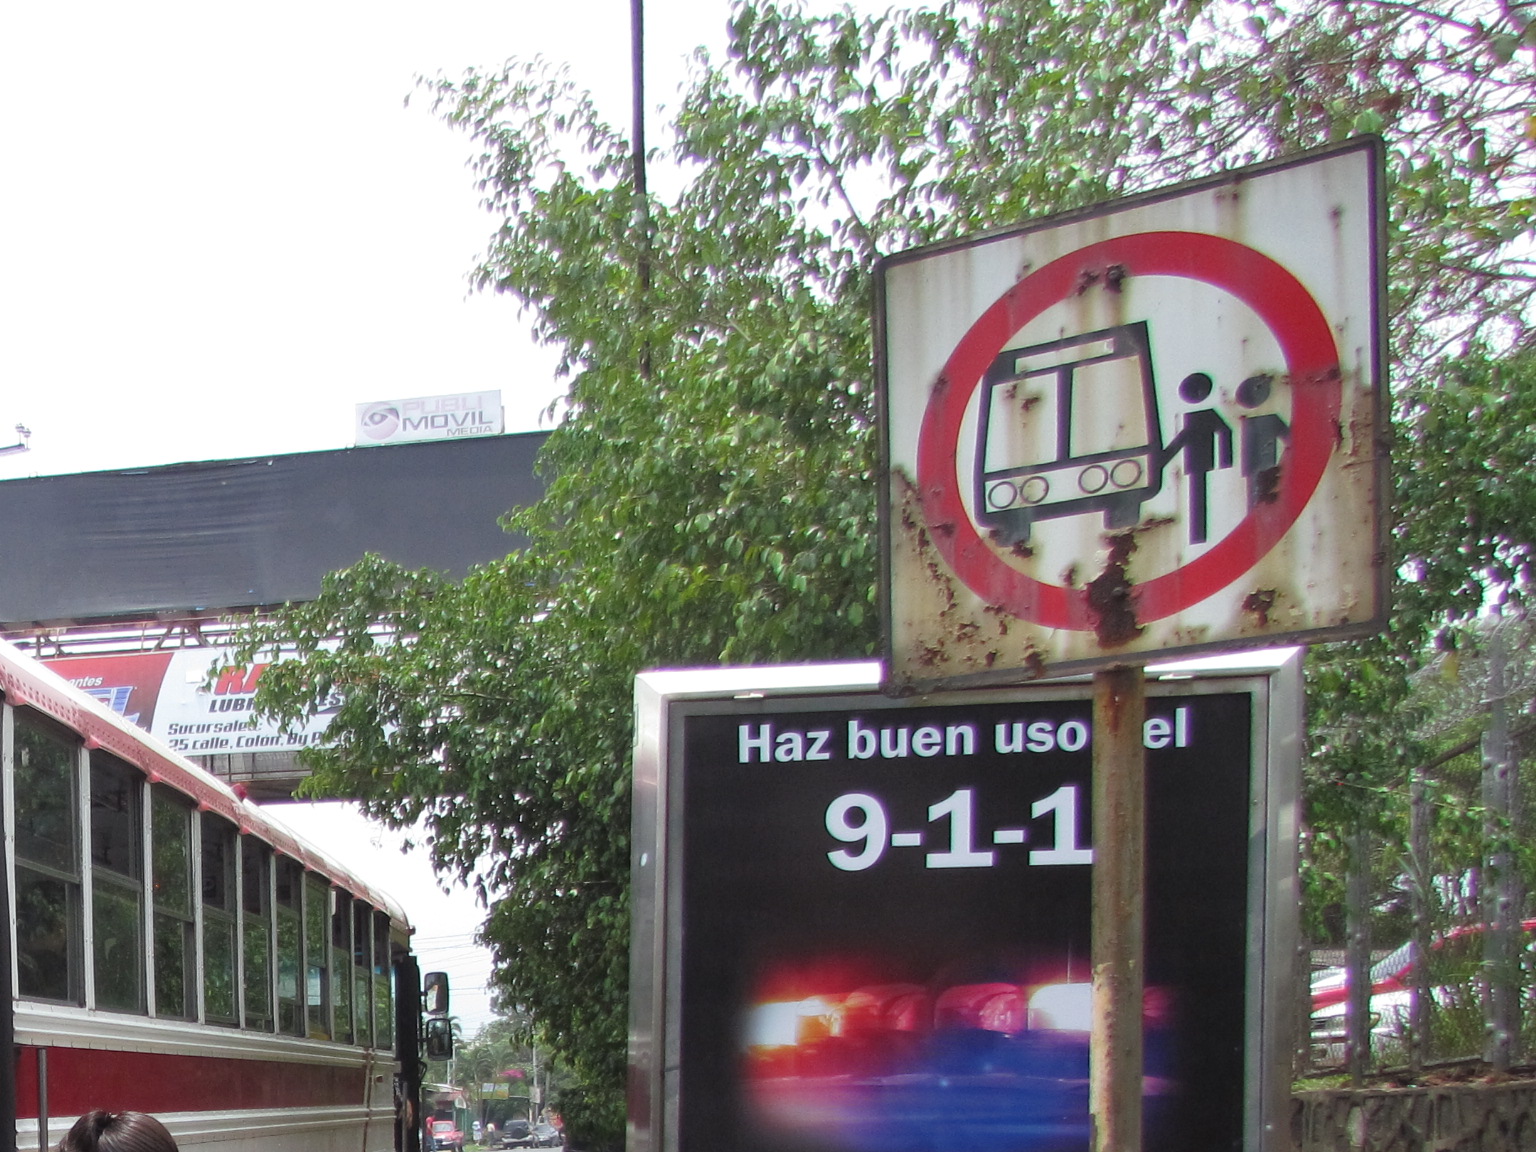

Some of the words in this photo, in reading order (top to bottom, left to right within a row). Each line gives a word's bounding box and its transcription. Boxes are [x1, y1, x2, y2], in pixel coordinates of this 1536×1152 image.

[402, 396, 483, 415] PUBLI
[402, 411, 493, 431] MOVIL
[447, 426, 494, 437] MEDIA
[737, 723, 831, 764] Haz
[847, 719, 975, 759] buen
[995, 718, 1087, 754] uso
[1143, 706, 1188, 750] el
[824, 785, 1094, 872] 9-1-1
